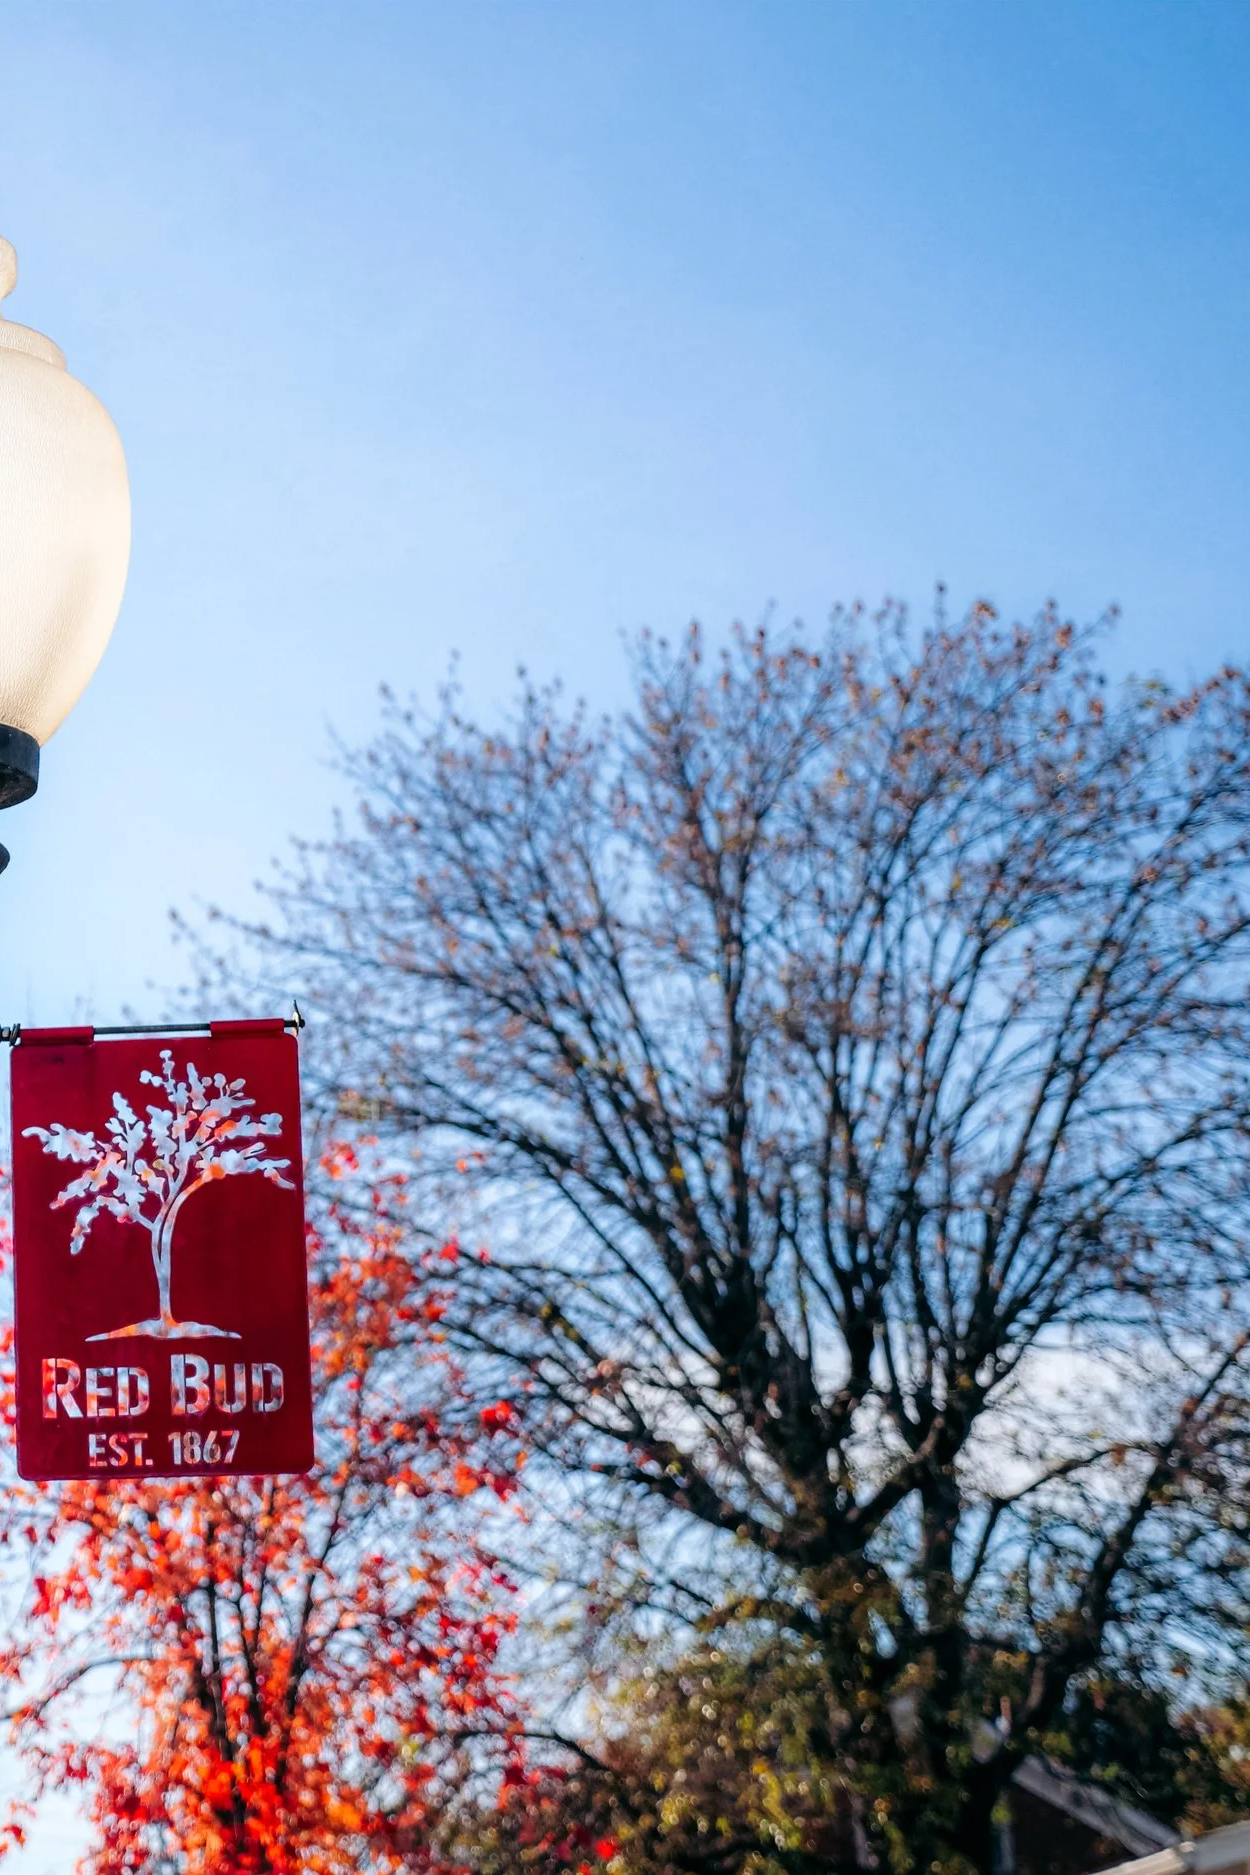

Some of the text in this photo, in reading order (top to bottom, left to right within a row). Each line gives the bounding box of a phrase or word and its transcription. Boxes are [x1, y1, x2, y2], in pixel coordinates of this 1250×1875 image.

[41, 1353, 285, 1419] RED BUD
[88, 1429, 241, 1467] EST. 1867
